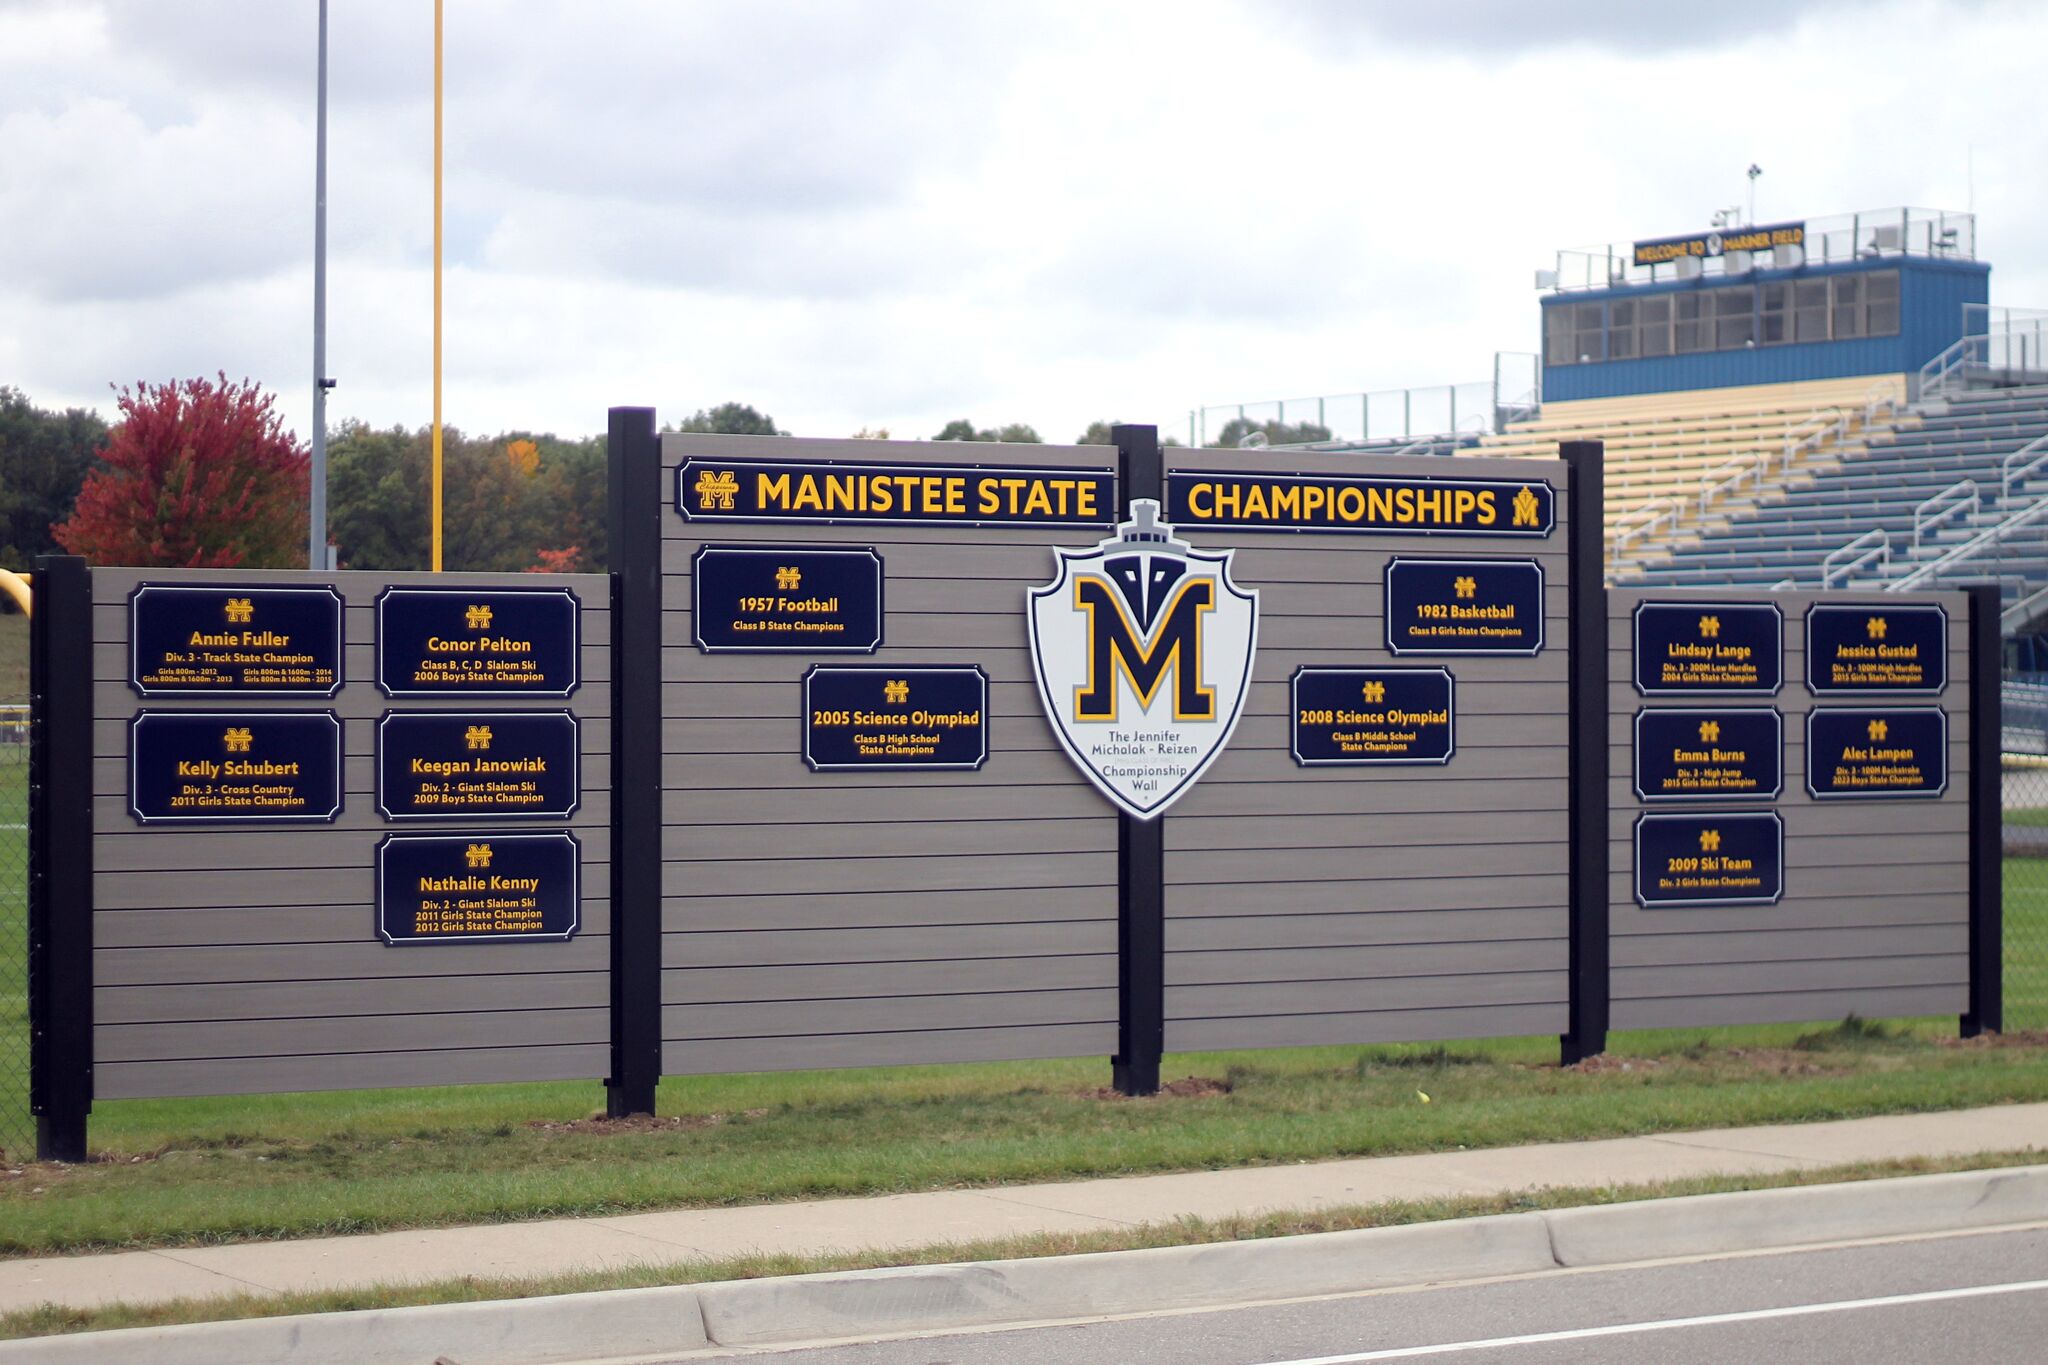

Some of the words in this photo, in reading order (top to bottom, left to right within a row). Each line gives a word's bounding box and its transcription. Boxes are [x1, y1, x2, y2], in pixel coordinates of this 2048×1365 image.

[757, 474, 966, 512] MANISTEE
[978, 479, 1097, 515] STATE
[1189, 484, 1496, 524] CHAMPIONSHIPS
[740, 598, 772, 611] 1957
[778, 598, 838, 612] Football
[1417, 605, 1447, 618] 1982
[1451, 605, 1514, 618] Basketball
[734, 622, 757, 630] Class
[760, 622, 766, 630] B
[768, 622, 792, 630] State
[794, 622, 844, 632] Champions
[1409, 627, 1430, 635] Class
[1432, 627, 1437, 635] B
[1439, 627, 1456, 635] Girls
[1458, 627, 1478, 635] State
[1480, 627, 1521, 636] Champions
[190, 632, 238, 646] Annie
[243, 632, 289, 646] Fuller
[428, 637, 475, 651] Conor
[481, 637, 531, 651] Pelton
[1073, 572, 1217, 724] M
[1669, 643, 1713, 659] Lindsay
[1716, 644, 1751, 659] Lange
[1837, 645, 1876, 657] Jessica
[1879, 644, 1917, 657] Gustad
[166, 653, 186, 662] Div.
[189, 653, 194, 661] 3
[204, 653, 231, 662] Track
[234, 654, 260, 662] State
[263, 654, 313, 664] Champion
[422, 661, 447, 670] Class
[450, 661, 459, 671] B,
[462, 661, 471, 671] C,
[475, 661, 481, 669] D
[487, 661, 518, 670] Slalom
[522, 661, 536, 670] Ski
[415, 672, 439, 681] 2006
[442, 672, 465, 682] Boys
[468, 672, 493, 681] State
[496, 672, 543, 682] Champion
[814, 712, 849, 724] 2005
[854, 712, 907, 724] Science
[912, 711, 979, 728] Olympiad
[1301, 711, 1333, 723] 2008
[1336, 711, 1383, 723] Science
[1387, 710, 1447, 726] Olympiad
[854, 735, 877, 743] Class
[880, 735, 885, 743] B
[888, 735, 908, 745] High
[910, 734, 939, 743] School
[1109, 731, 1129, 742] The
[1133, 731, 1180, 741] Jennifer
[1333, 733, 1353, 741] Class
[1362, 732, 1388, 740] Middle
[1390, 732, 1416, 740] School
[860, 746, 883, 754] State
[886, 745, 934, 756] Champions
[1092, 744, 1145, 755] Michalak
[1159, 744, 1197, 754] Reizen
[1342, 743, 1362, 751] State
[1365, 742, 1407, 752] Champions
[1674, 750, 1709, 761] Emma
[1712, 749, 1745, 761] Burns
[1843, 747, 1867, 760] Alec
[1870, 747, 1913, 761] Lampen
[179, 761, 220, 778] Kelly
[225, 761, 298, 775] Schubert
[412, 759, 469, 775] Keegan
[475, 758, 545, 772] Janowiak
[1103, 765, 1187, 777] Championship
[183, 786, 204, 794] Div.
[206, 786, 211, 794] 3
[221, 786, 249, 794] Cross
[253, 785, 293, 796] Country
[422, 783, 440, 792] Div.
[443, 783, 449, 792] 2
[458, 783, 484, 792] Giant
[487, 783, 518, 791] Slalom
[522, 782, 535, 791] Ski
[1132, 780, 1157, 790] Wall
[171, 797, 195, 805] 2011
[198, 797, 222, 805] Girls
[224, 797, 251, 805] State
[254, 796, 304, 806] Champion
[414, 794, 439, 803] 2009
[442, 794, 465, 804] Boys
[468, 794, 493, 802] State
[496, 794, 543, 803] Champion
[1669, 858, 1698, 871] 2009
[1701, 858, 1718, 870] Ski
[1721, 857, 1751, 869] Team
[421, 877, 486, 891] Nathalie
[491, 876, 538, 892] Kenny
[423, 901, 441, 909] Div.
[444, 900, 449, 908] 2
[459, 900, 484, 908] Giant
[487, 899, 518, 908] Slalom
[522, 898, 535, 907] Ski
[416, 912, 438, 920] 2011
[442, 911, 463, 920] Girls
[467, 911, 491, 919] State
[495, 910, 542, 919] Champion
[416, 923, 438, 931] 2012
[442, 922, 463, 931] Girls
[467, 922, 491, 931] State
[495, 921, 542, 930] Champion
